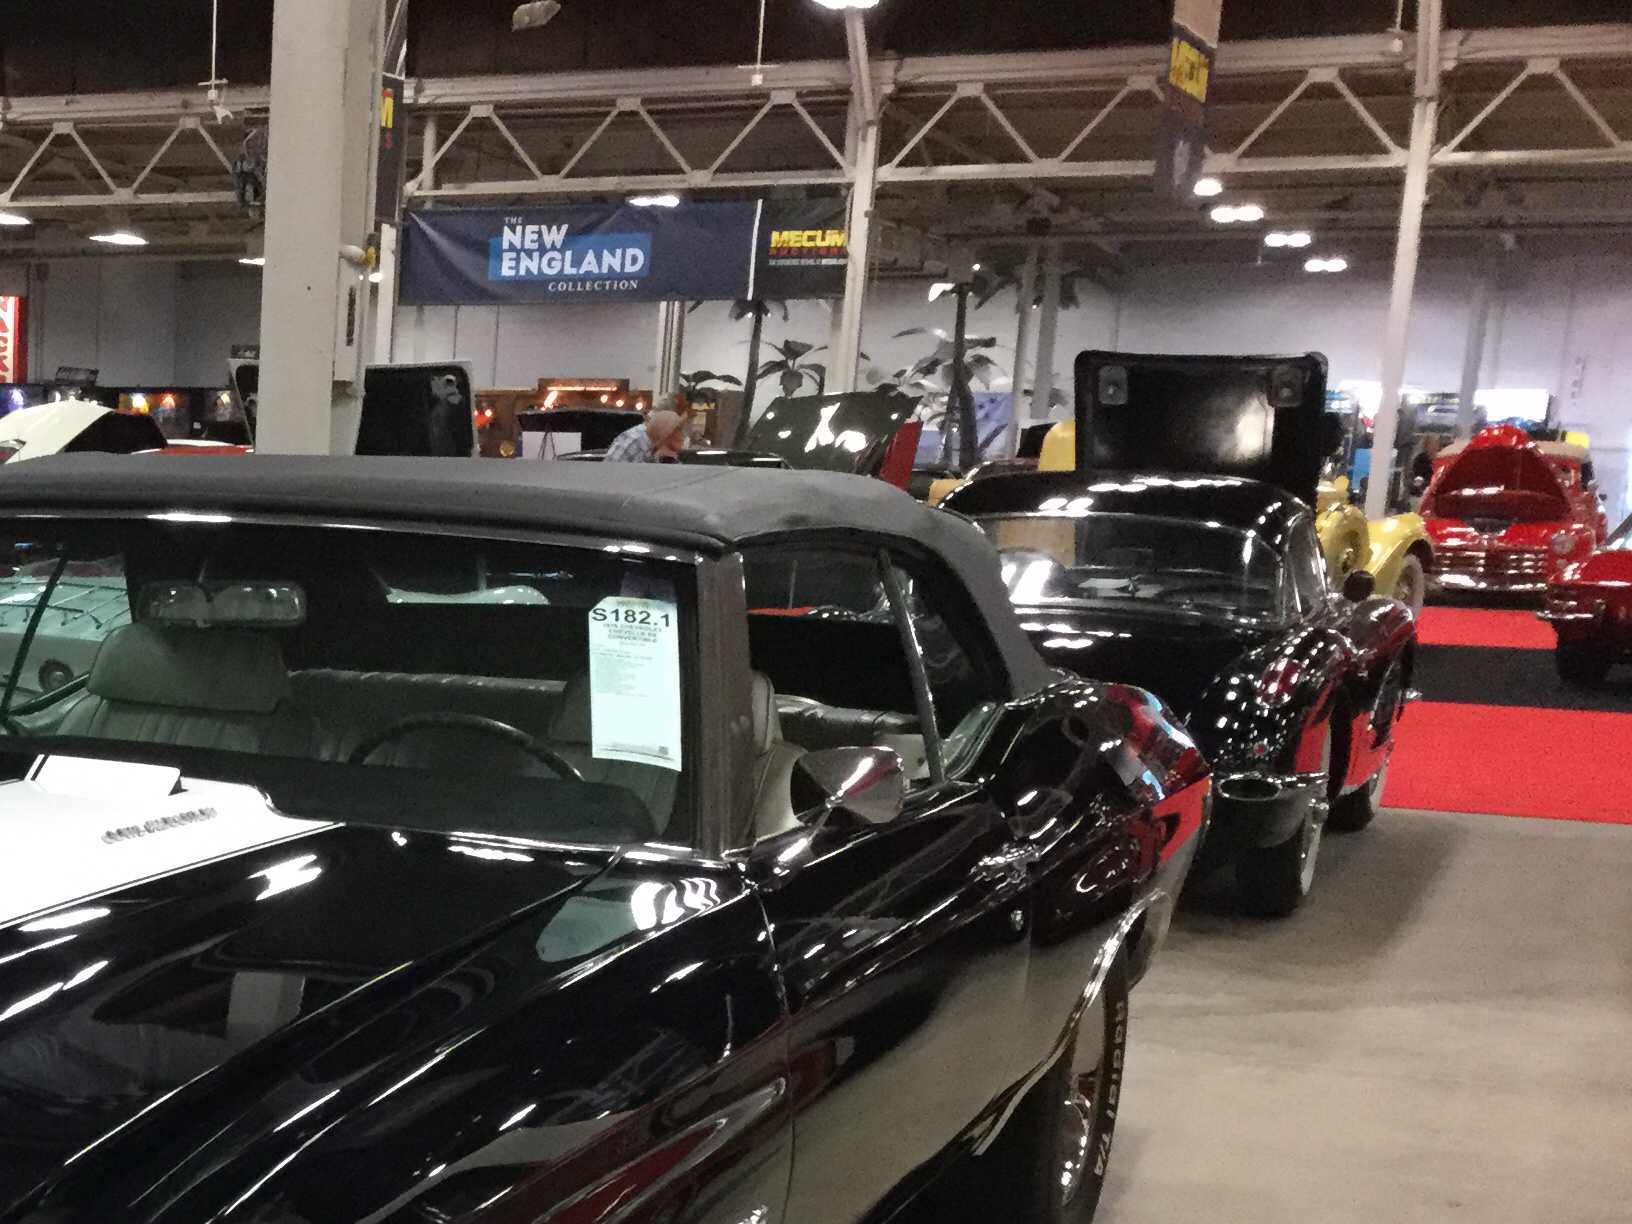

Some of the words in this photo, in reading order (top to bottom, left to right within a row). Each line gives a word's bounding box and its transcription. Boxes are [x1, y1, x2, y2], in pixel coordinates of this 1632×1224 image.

[502, 224, 568, 250] NEW
[771, 230, 847, 247] MECUM
[501, 248, 645, 276] ENGLAND
[548, 280, 639, 292] COLLECTION
[592, 608, 670, 628] S182.1
